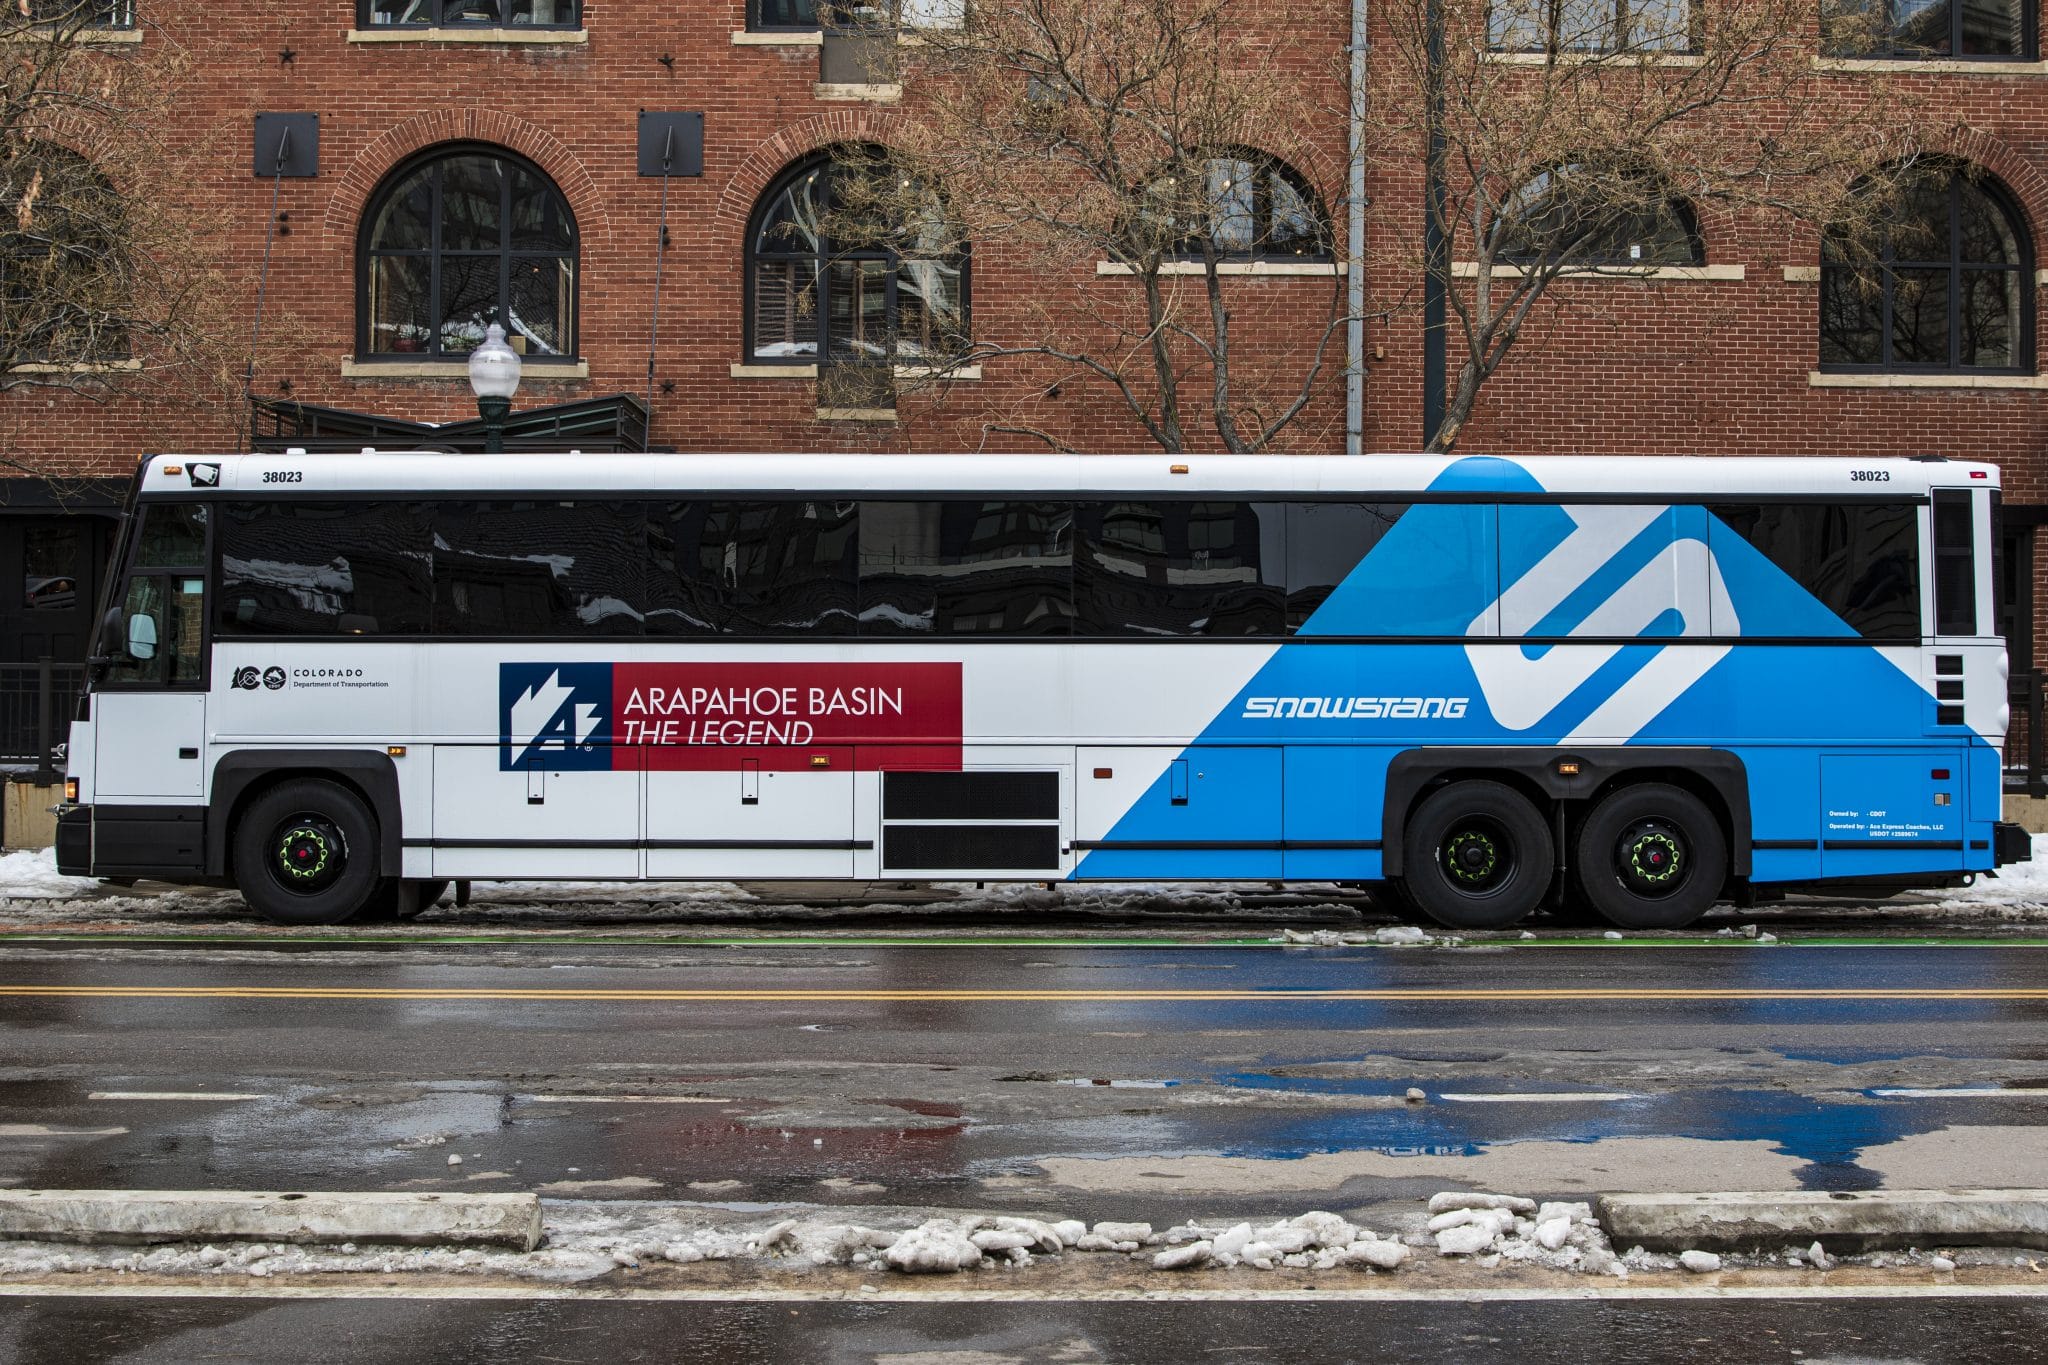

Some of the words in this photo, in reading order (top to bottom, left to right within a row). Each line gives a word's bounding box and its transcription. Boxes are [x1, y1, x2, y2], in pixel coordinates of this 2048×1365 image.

[262, 471, 303, 483] 38023
[1850, 471, 1890, 482] 38023
[293, 669, 363, 677] COLORADO
[293, 681, 331, 689] Department
[341, 681, 389, 689] Transportation
[623, 687, 798, 716] ARAPAHOE
[809, 687, 902, 716] BASIN
[623, 720, 681, 745] THE
[687, 719, 814, 745] LEGEND
[1882, 823, 1905, 831] Express
